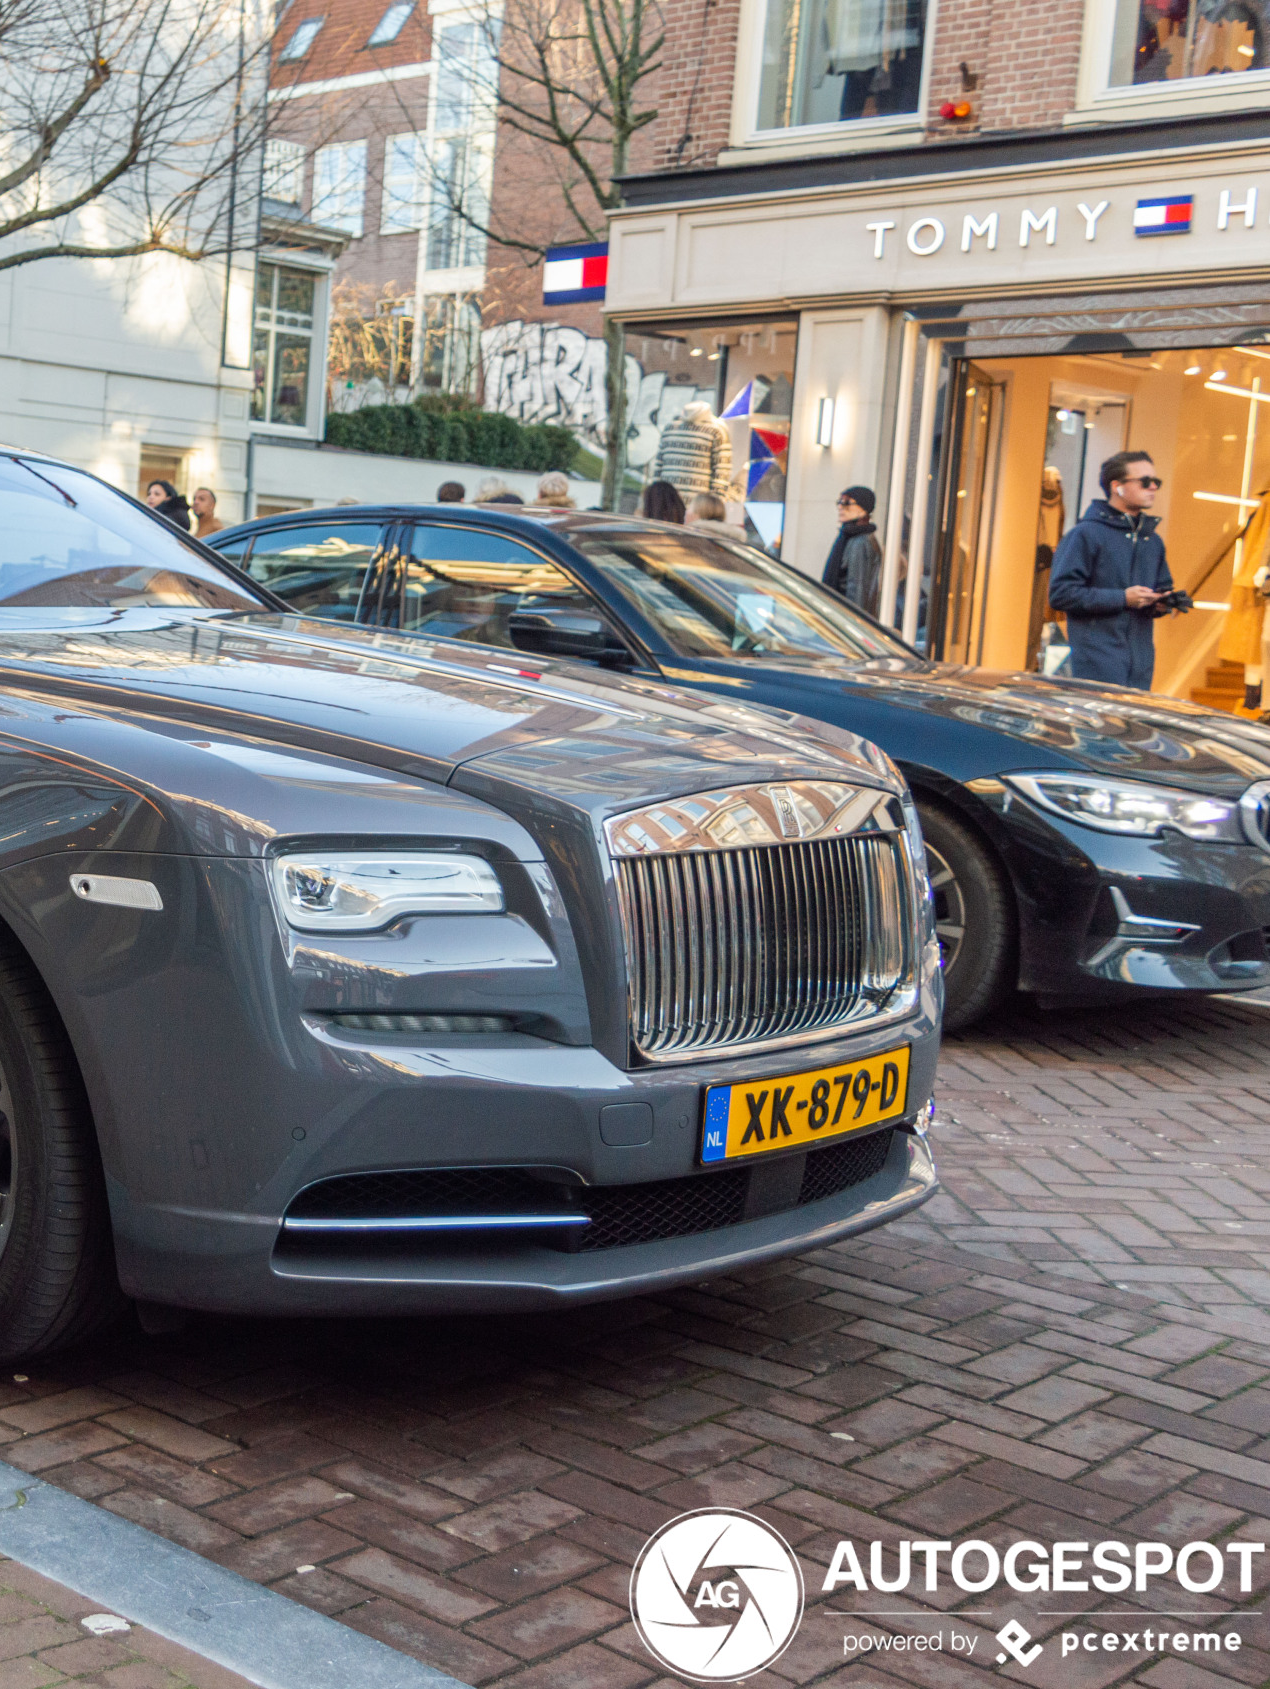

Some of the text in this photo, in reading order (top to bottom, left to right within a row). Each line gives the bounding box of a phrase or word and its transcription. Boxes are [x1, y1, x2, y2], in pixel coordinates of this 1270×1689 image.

[866, 186, 1270, 260] TOMMY H
[706, 1131, 723, 1148] NL
[740, 1061, 899, 1145] XK-879-D
